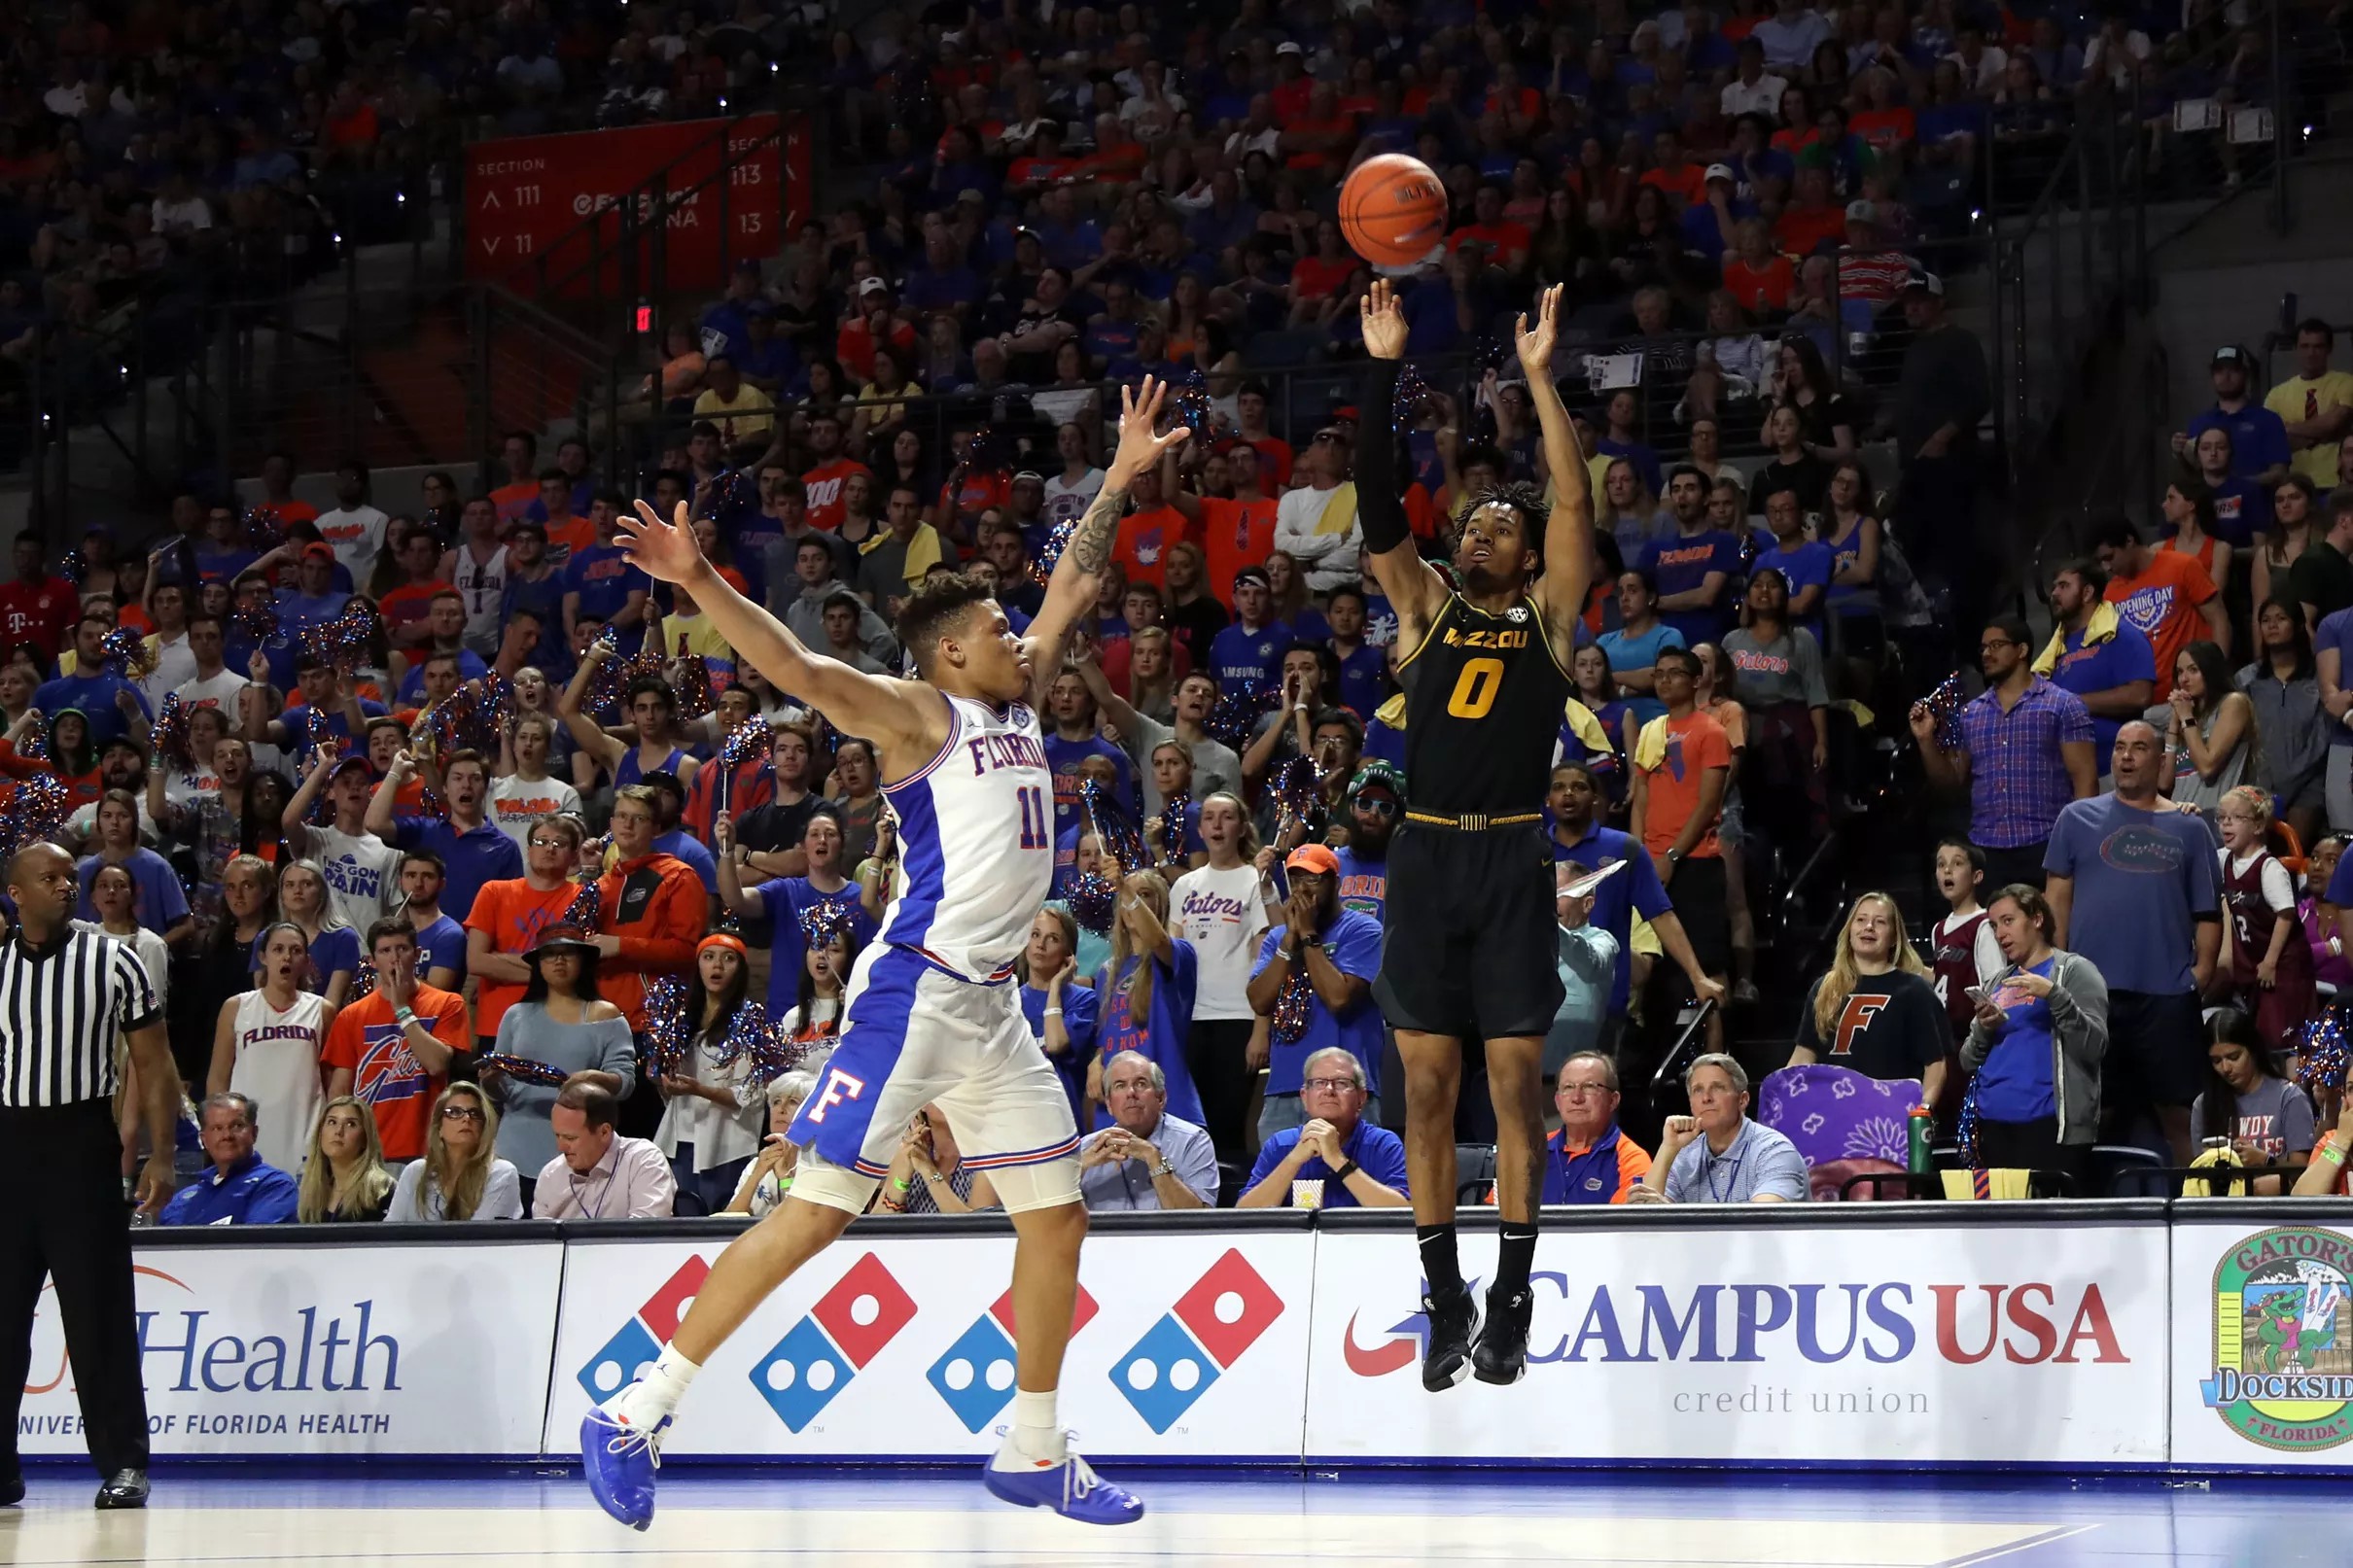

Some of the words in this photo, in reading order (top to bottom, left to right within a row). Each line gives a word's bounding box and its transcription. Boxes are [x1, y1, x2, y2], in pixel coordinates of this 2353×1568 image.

[476, 158, 545, 176] SECTION
[731, 164, 761, 187] 113
[514, 185, 541, 206] 111
[740, 213, 761, 234] 13
[515, 233, 532, 255] 11
[2115, 593, 2155, 616] OPENING
[2155, 585, 2172, 605] DAY
[1447, 657, 1504, 719] 0
[1016, 785, 1048, 850] 11
[1829, 993, 1892, 1056] F
[243, 1026, 319, 1050] FLORIDA
[806, 1066, 867, 1125] F
[2238, 1115, 2274, 1137] WDY
[1928, 1282, 2131, 1364] USA
[136, 1299, 402, 1393] Health
[2218, 1366, 2353, 1403] DOCKSID
[1673, 1384, 1793, 1413] credit
[1810, 1386, 1930, 1413] union
[147, 1414, 176, 1435] OF
[186, 1414, 288, 1435] FLORIDA
[298, 1413, 391, 1435] HEALTH
[2260, 1423, 2339, 1443] FLORIDA
